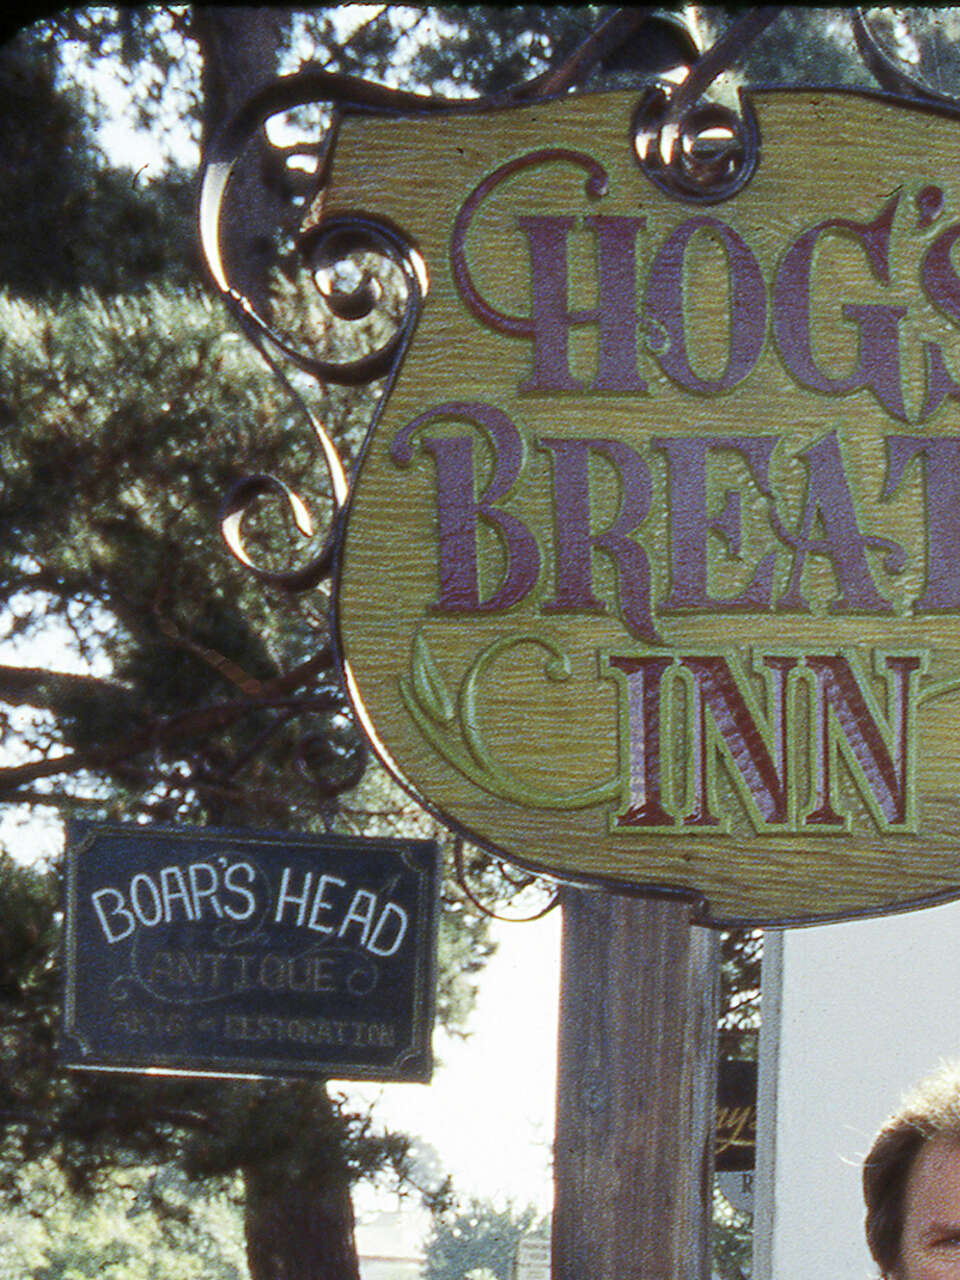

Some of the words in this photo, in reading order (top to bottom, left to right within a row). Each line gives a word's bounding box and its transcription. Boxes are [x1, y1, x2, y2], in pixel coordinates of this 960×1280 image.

[602, 651, 924, 834] INN
[91, 856, 256, 944] BOAR'S
[274, 867, 408, 957] HEAD
[151, 949, 336, 993] ANTIQUE
